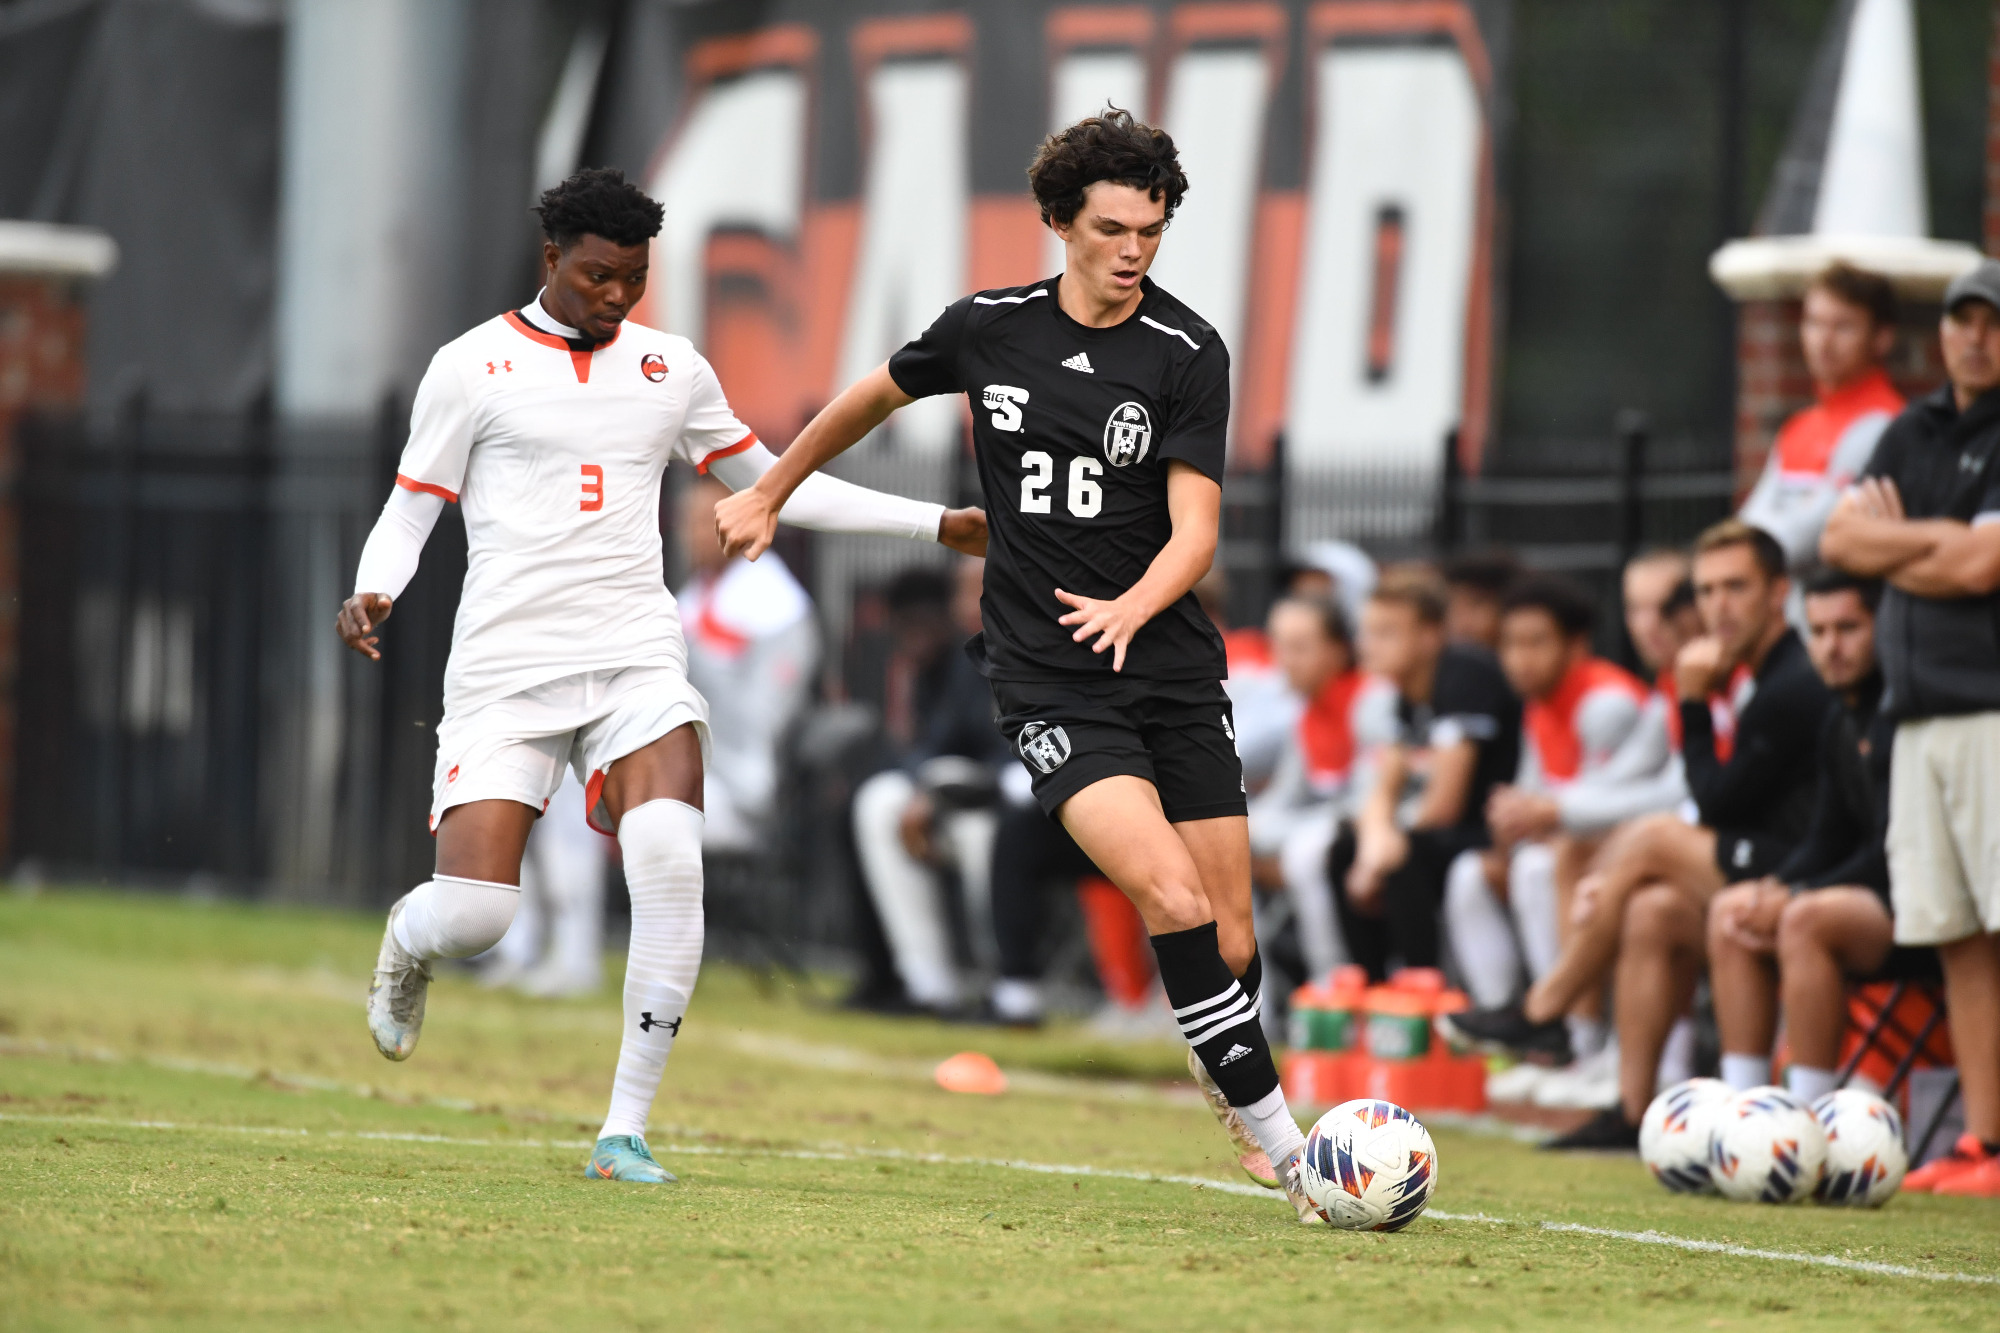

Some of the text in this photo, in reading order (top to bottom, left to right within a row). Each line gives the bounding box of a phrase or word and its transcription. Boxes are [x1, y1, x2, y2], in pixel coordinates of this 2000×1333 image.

[982, 390, 1006, 403] BIG
[1112, 419, 1147, 431] WINTHROP
[580, 464, 604, 511] 3
[1020, 450, 1104, 518] 26
[1219, 1047, 1253, 1067] adidas
